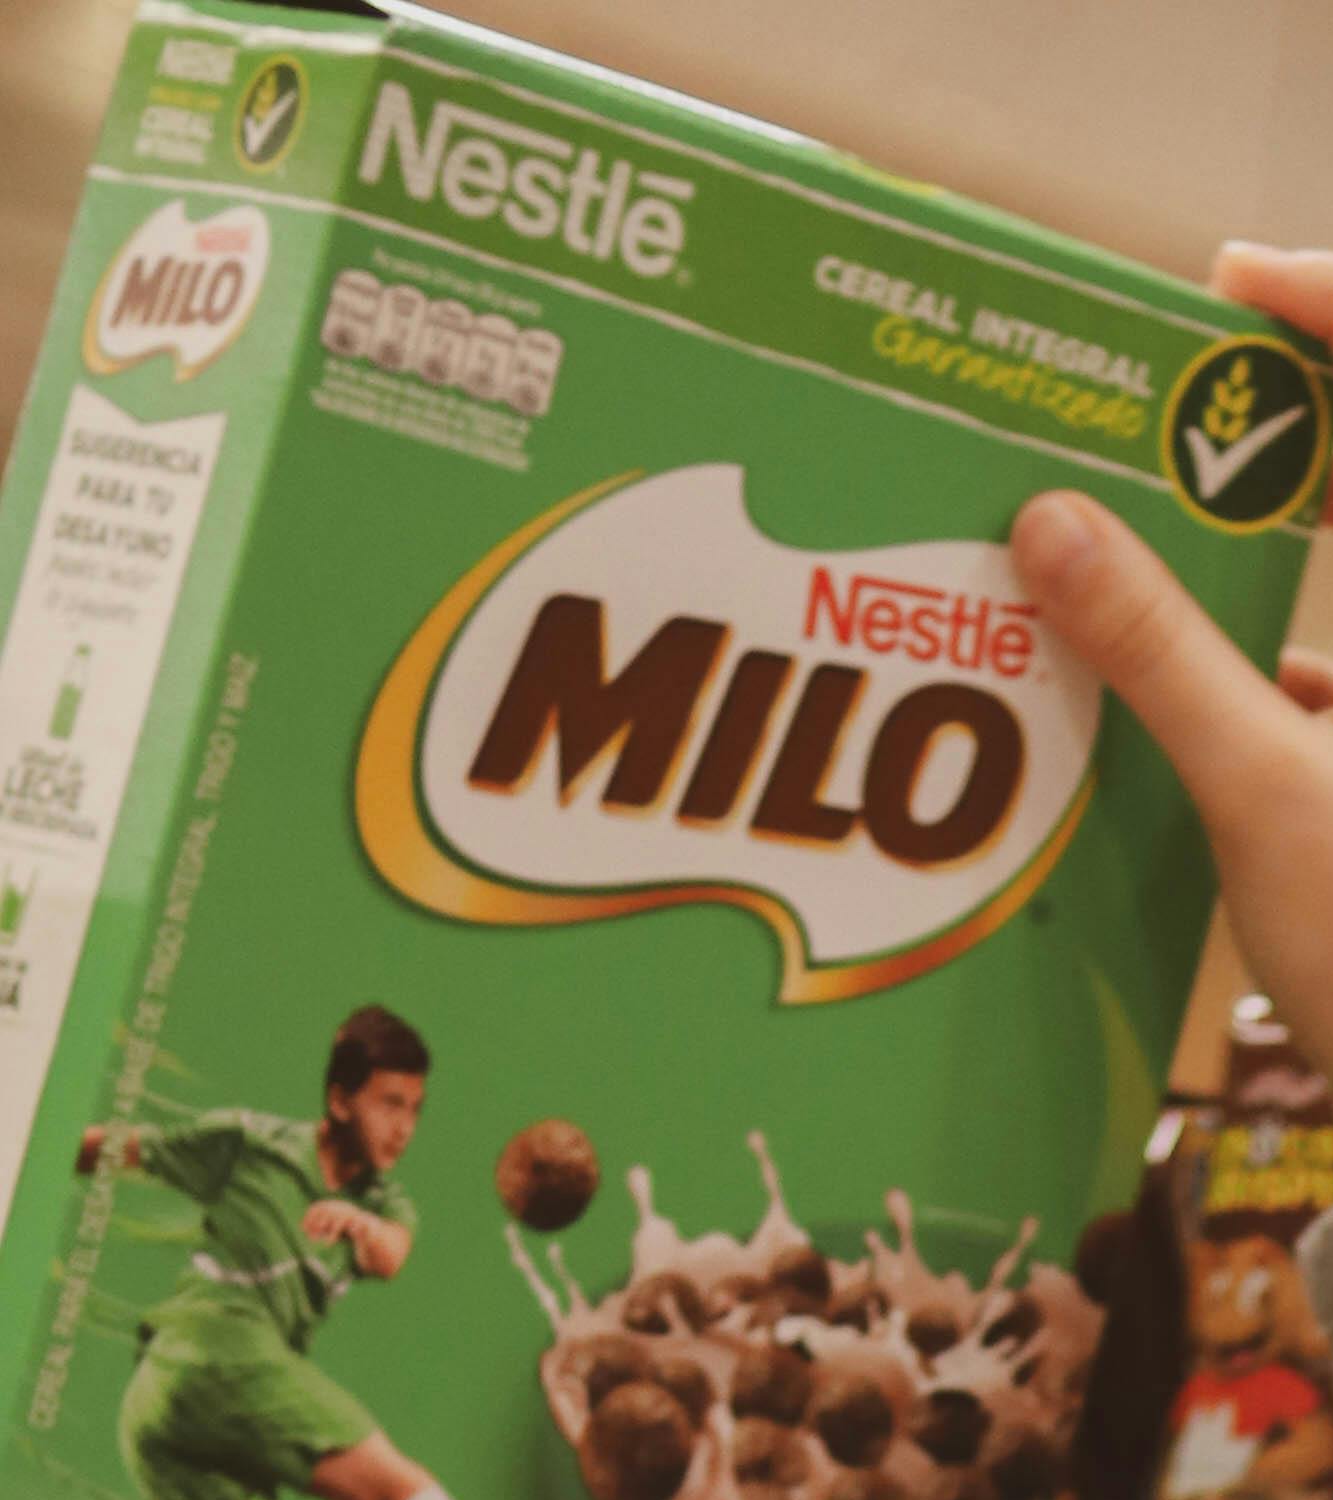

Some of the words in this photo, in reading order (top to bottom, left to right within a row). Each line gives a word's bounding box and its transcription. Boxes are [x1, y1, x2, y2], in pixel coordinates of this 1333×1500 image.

[358, 80, 695, 278] Nestlé
[110, 255, 247, 331] MILO
[814, 256, 961, 334] CEREAL
[972, 309, 1154, 399] INTEGRAL
[805, 566, 1040, 680] Nestlé
[466, 593, 1027, 871] MILO
